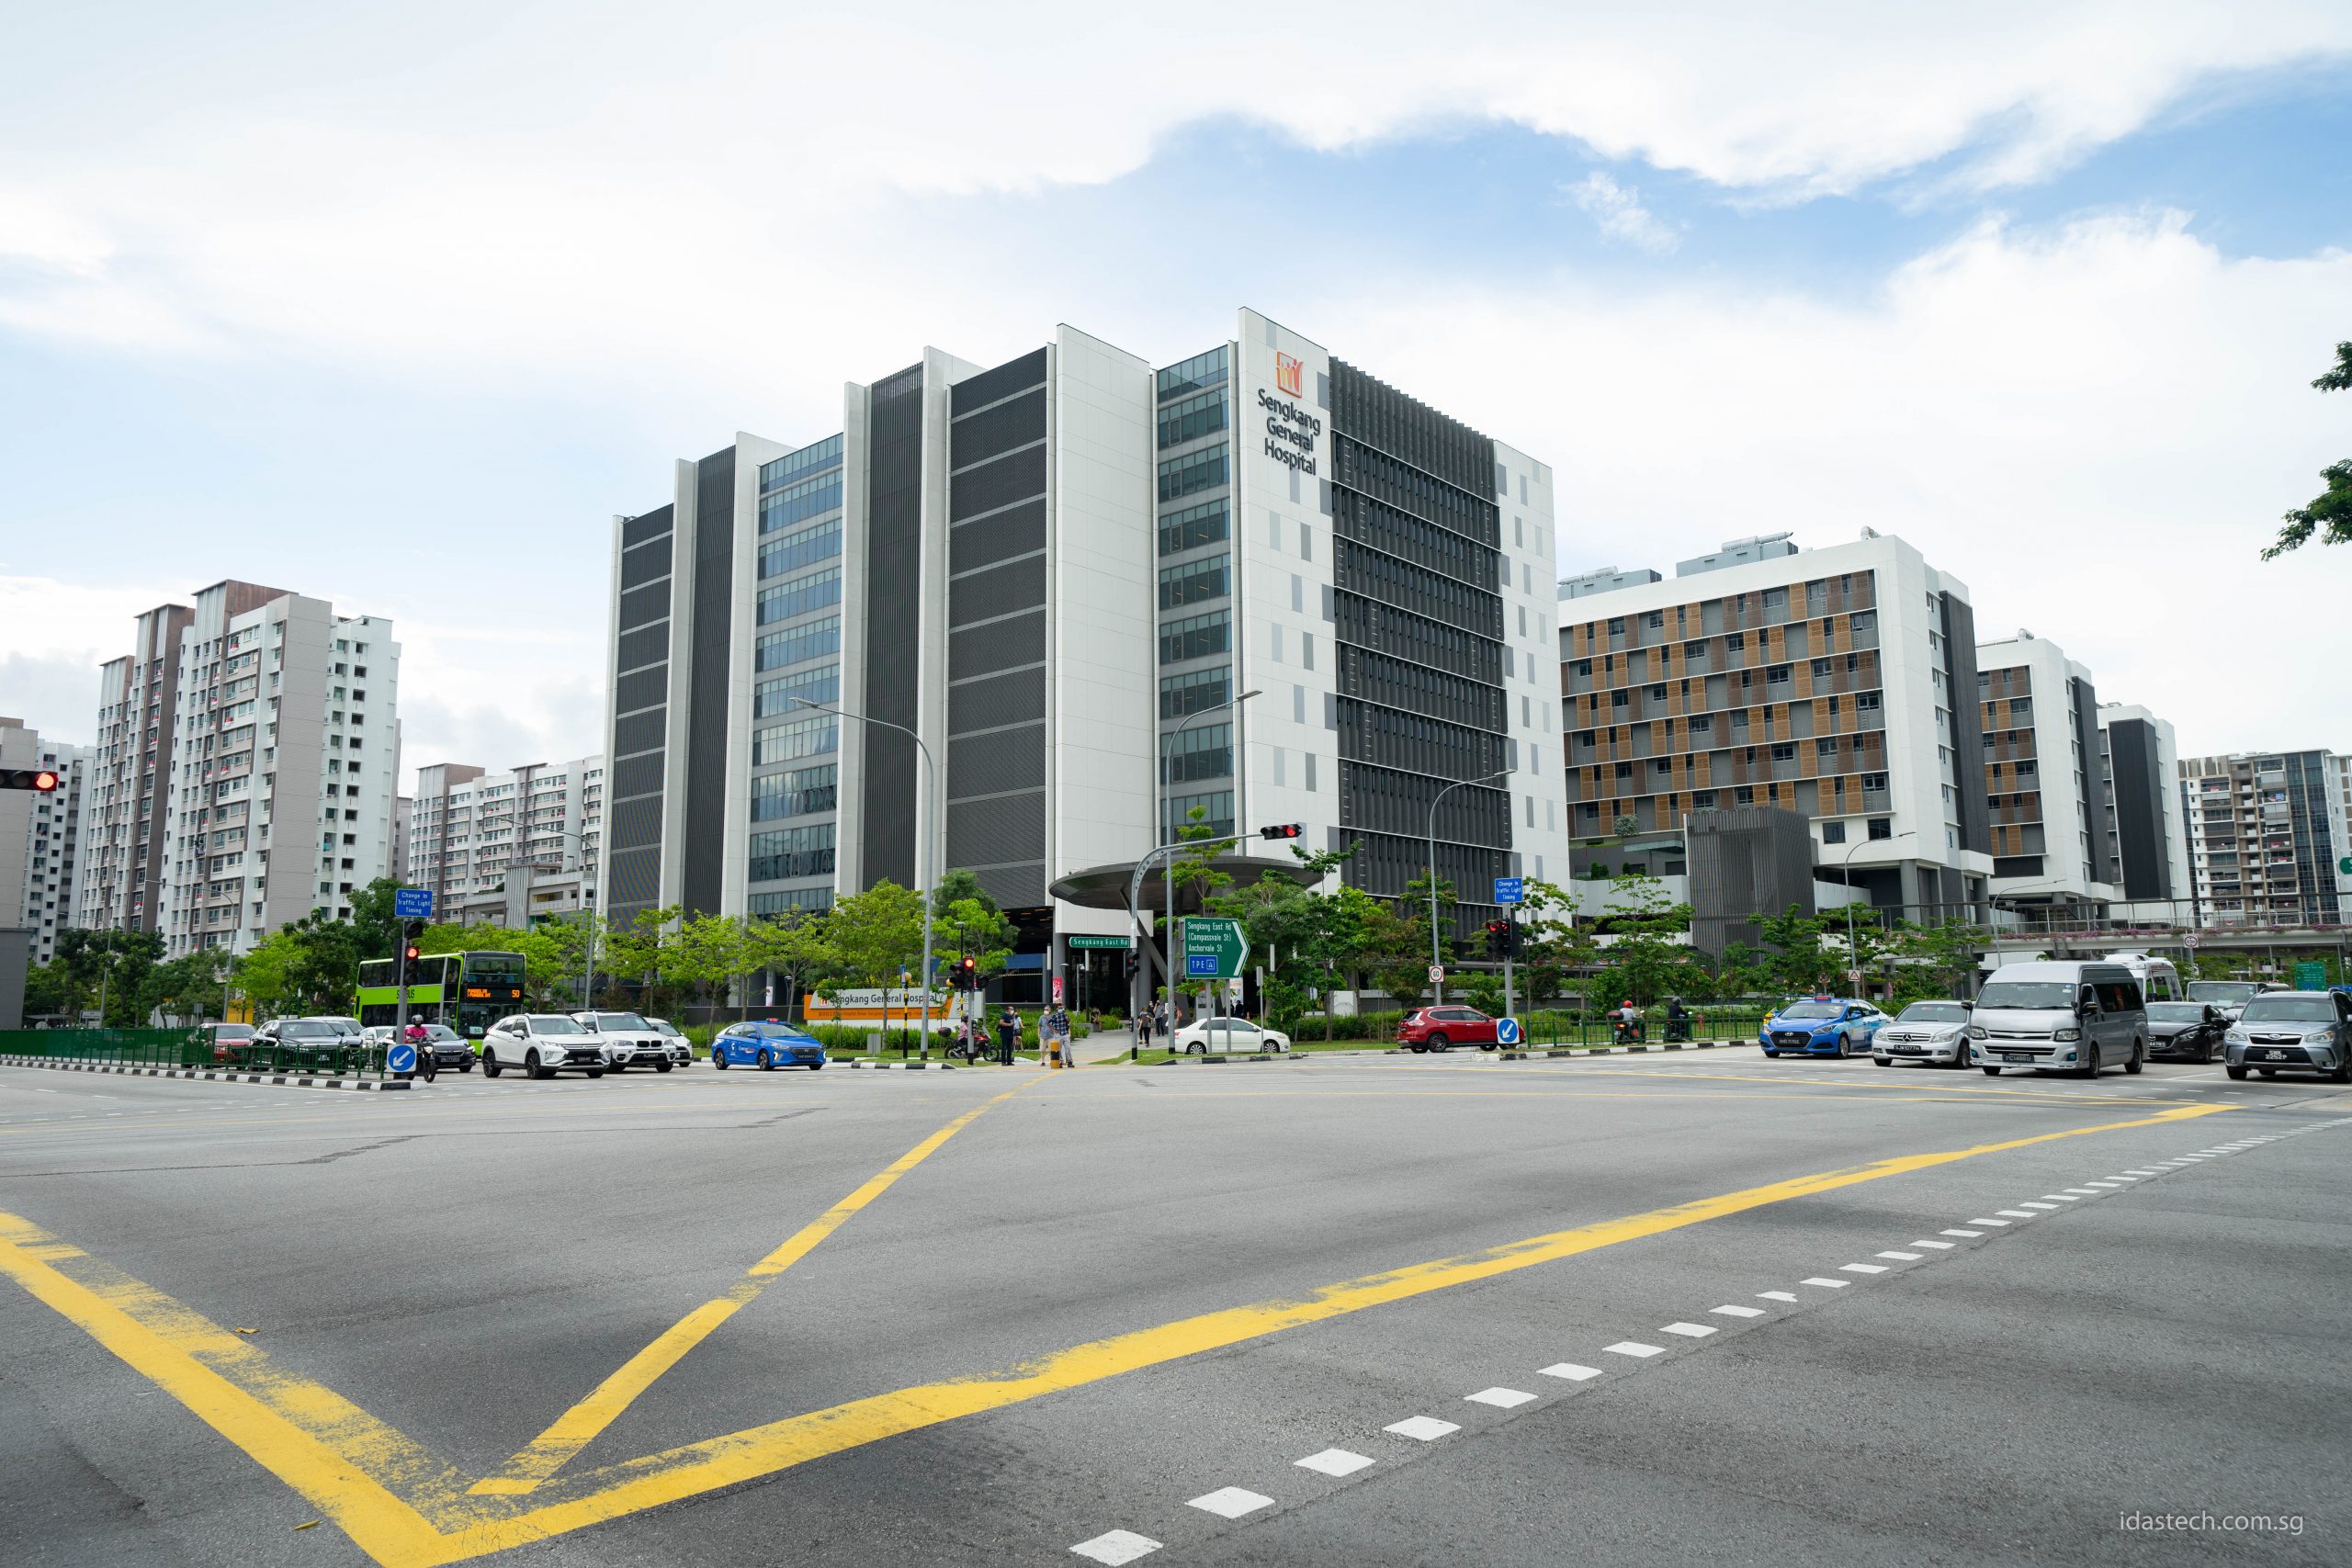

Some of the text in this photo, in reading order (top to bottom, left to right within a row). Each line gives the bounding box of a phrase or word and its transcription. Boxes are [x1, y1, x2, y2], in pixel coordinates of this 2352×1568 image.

[1258, 388, 1321, 436] Sengkang
[1267, 416, 1314, 452] General
[1264, 437, 1317, 476] Hospital
[401, 891, 420, 899] Change
[405, 907, 423, 915] Timing
[1188, 921, 1232, 932] Sengkang East Rd
[1073, 938, 1103, 947] Sengkang
[1188, 932, 1232, 943] (Compassvale St)
[1188, 943, 1223, 953] Anchorvale St
[1192, 960, 1204, 969] TPE
[512, 989, 520, 998] 50
